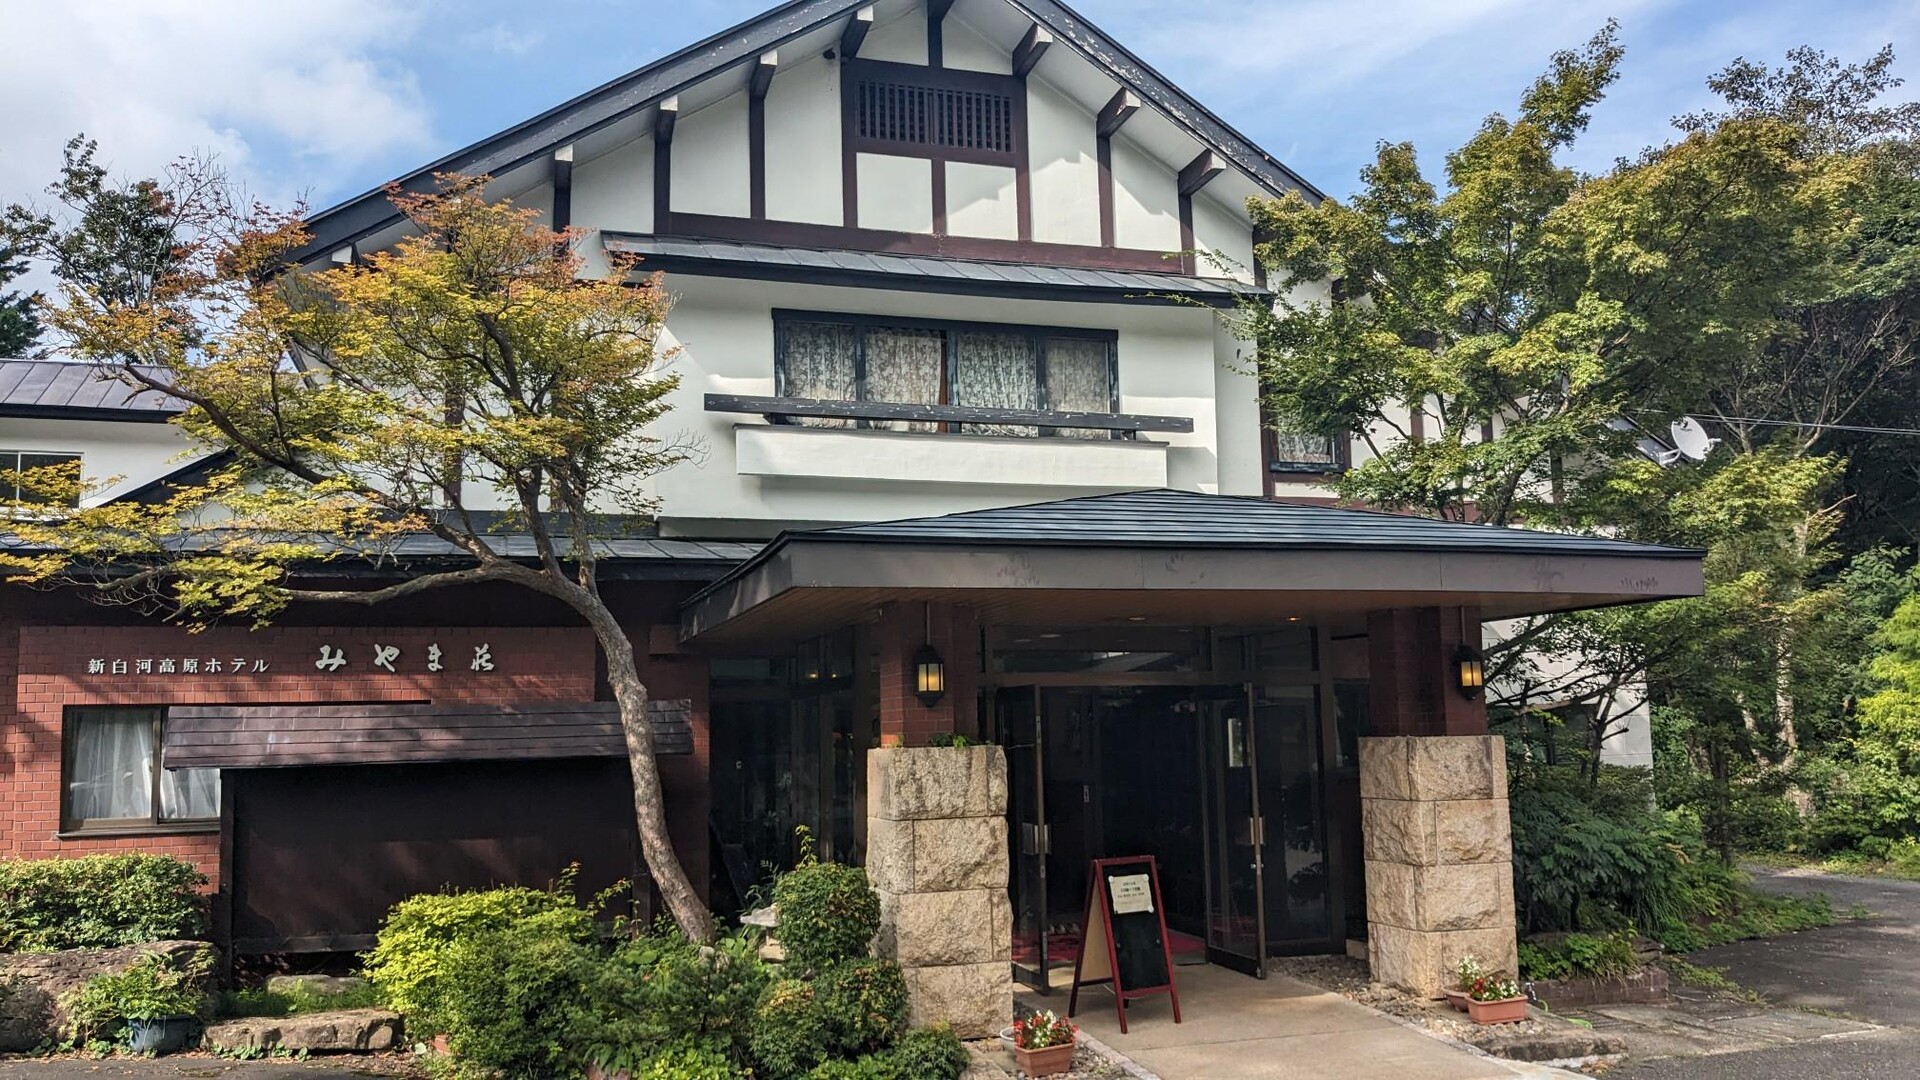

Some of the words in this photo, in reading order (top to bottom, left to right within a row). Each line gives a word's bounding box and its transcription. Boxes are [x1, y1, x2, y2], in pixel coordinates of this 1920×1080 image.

[88, 658, 271, 674] 新白河高原ホテル
[315, 643, 495, 672] みやま荘
